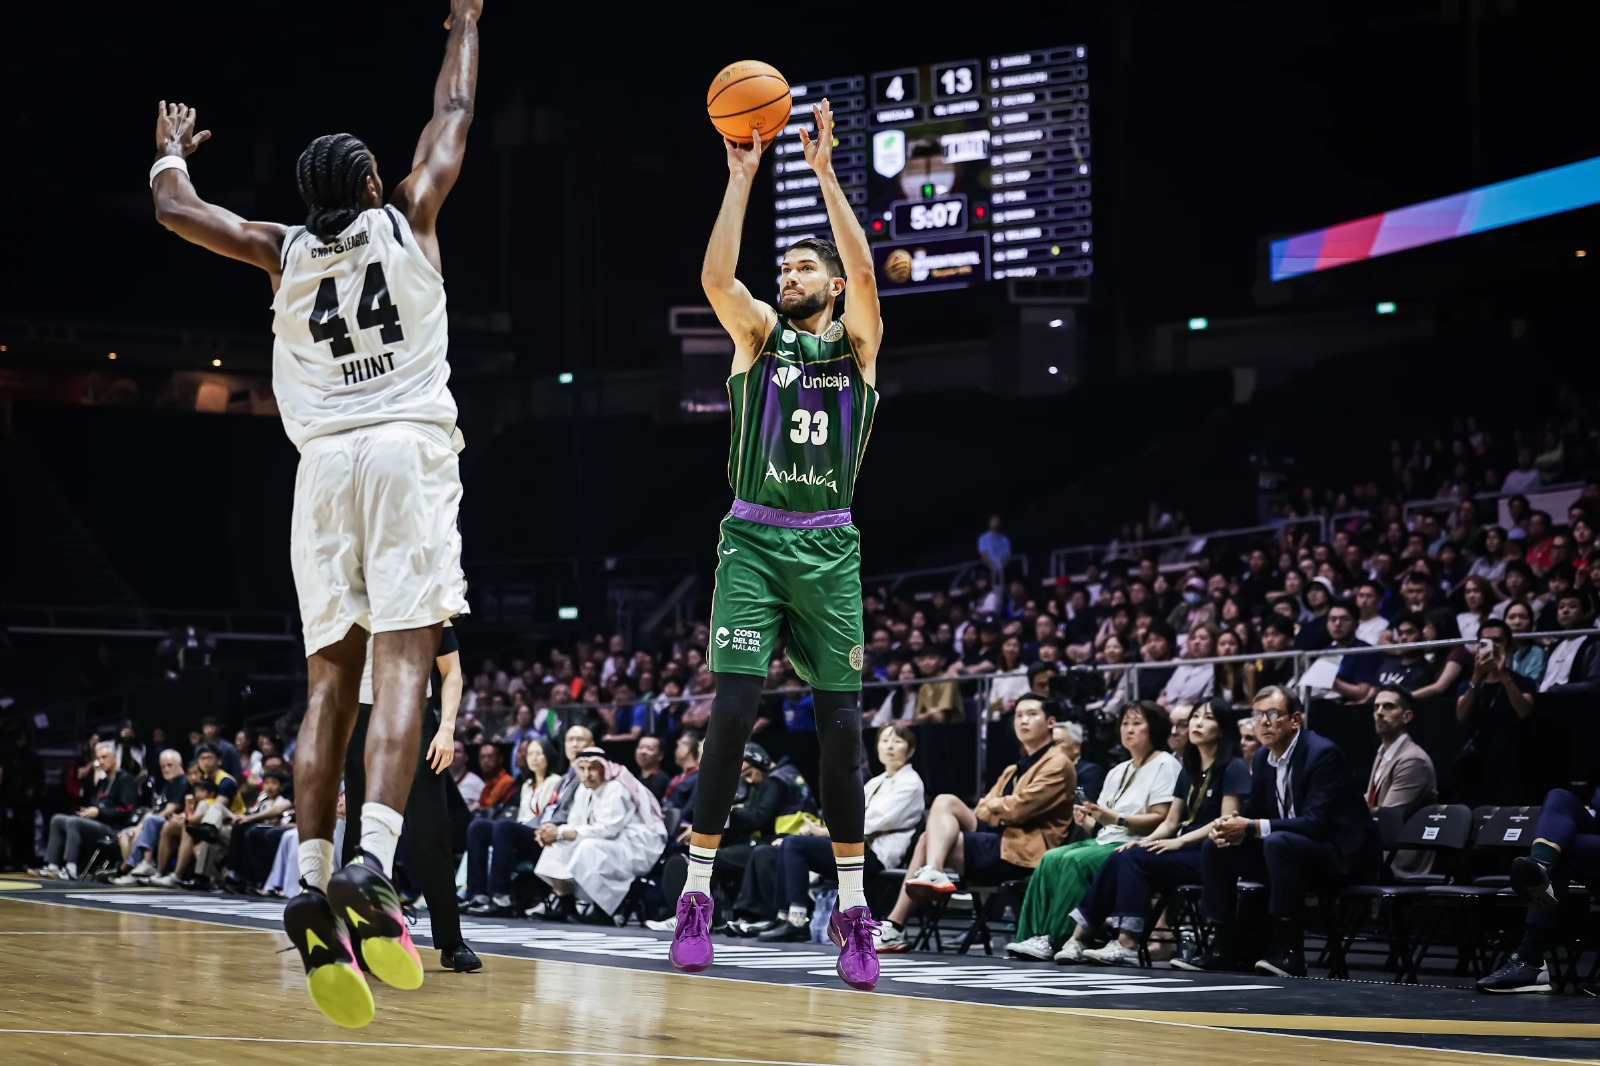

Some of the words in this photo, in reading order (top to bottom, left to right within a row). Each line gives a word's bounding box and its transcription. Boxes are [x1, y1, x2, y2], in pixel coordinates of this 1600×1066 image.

[886, 76, 905, 102] 4
[941, 67, 973, 95] 13
[910, 201, 962, 231] 5:07
[344, 230, 369, 251] LEAGUE
[309, 261, 404, 359] 44
[341, 352, 395, 386] HUNT
[802, 372, 850, 391] Unicaja
[789, 408, 829, 446] 33
[733, 628, 761, 639] COSTA
[731, 643, 760, 653] MÁLAGA
